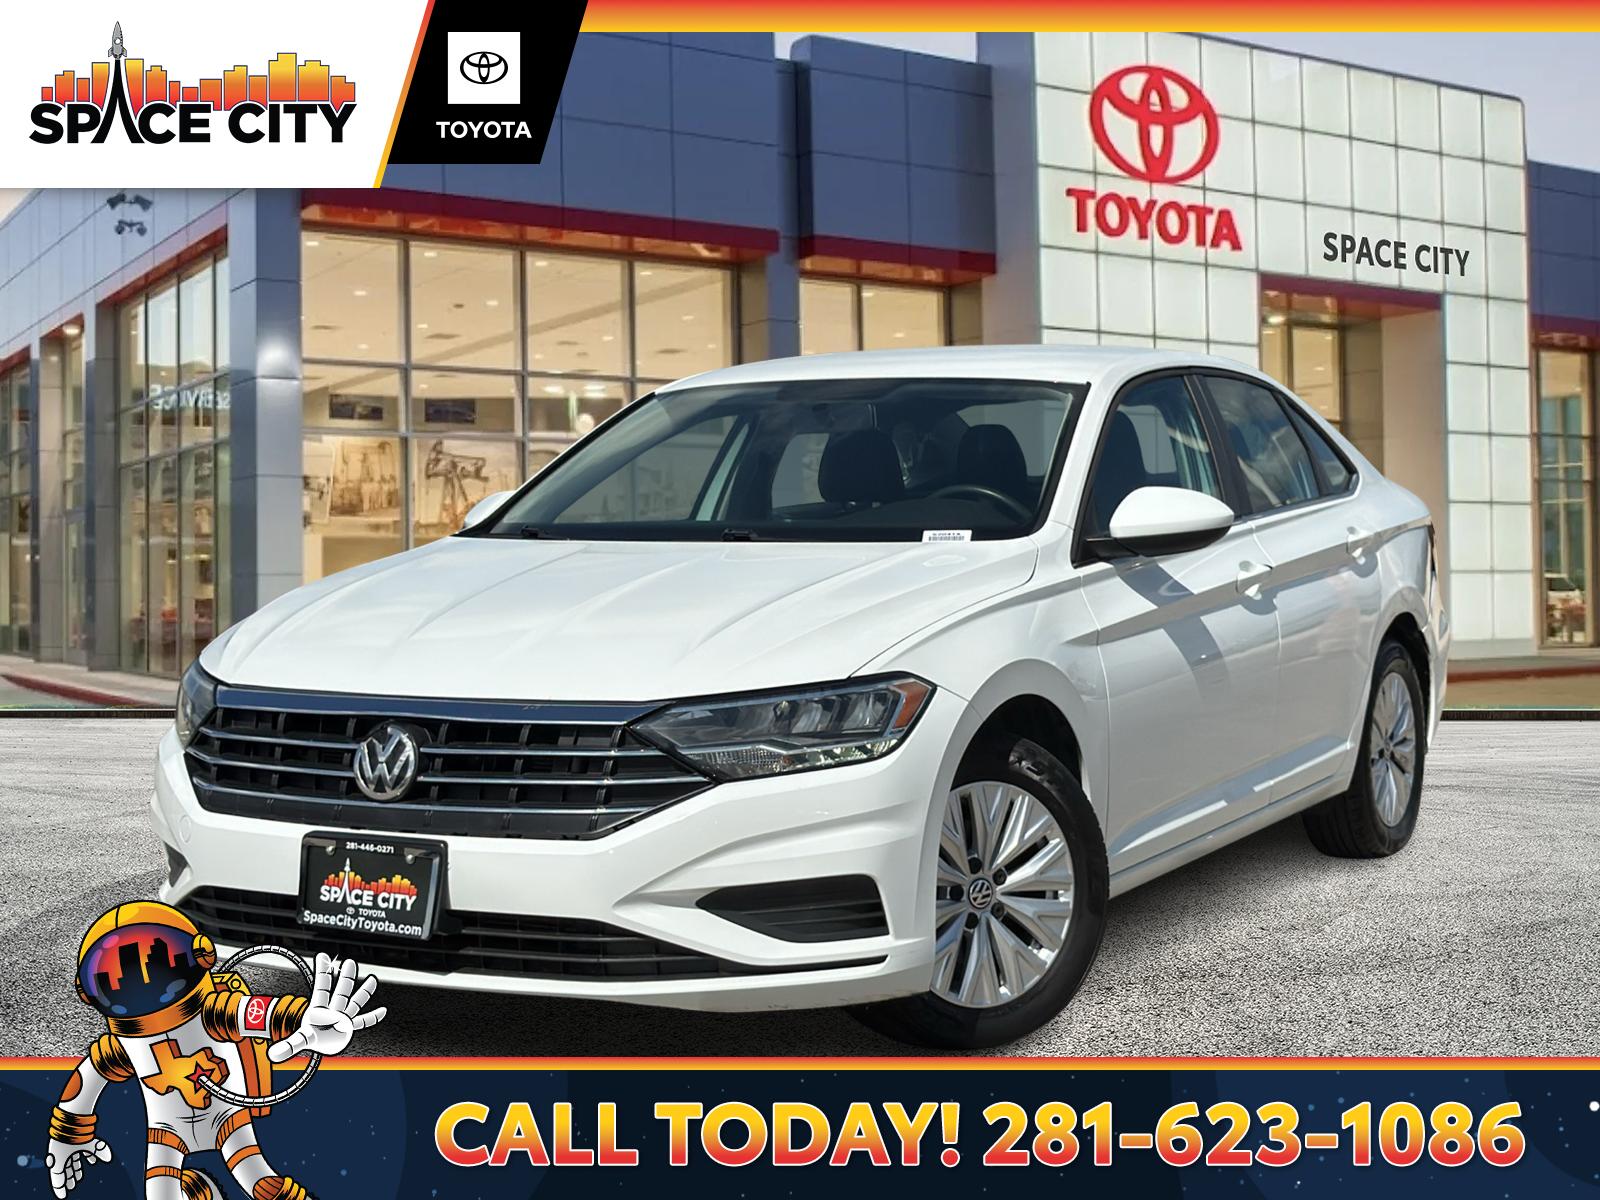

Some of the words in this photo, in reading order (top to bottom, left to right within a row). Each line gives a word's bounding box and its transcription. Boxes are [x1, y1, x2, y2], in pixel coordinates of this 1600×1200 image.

[1066, 187, 1243, 251] TOYOTA
[1323, 231, 1407, 270] SPACE
[1414, 244, 1470, 277] CITY
[358, 908, 386, 918] TOYOTA
[377, 892, 417, 911] CITY
[303, 910, 422, 936] SpaceCityToyota.com
